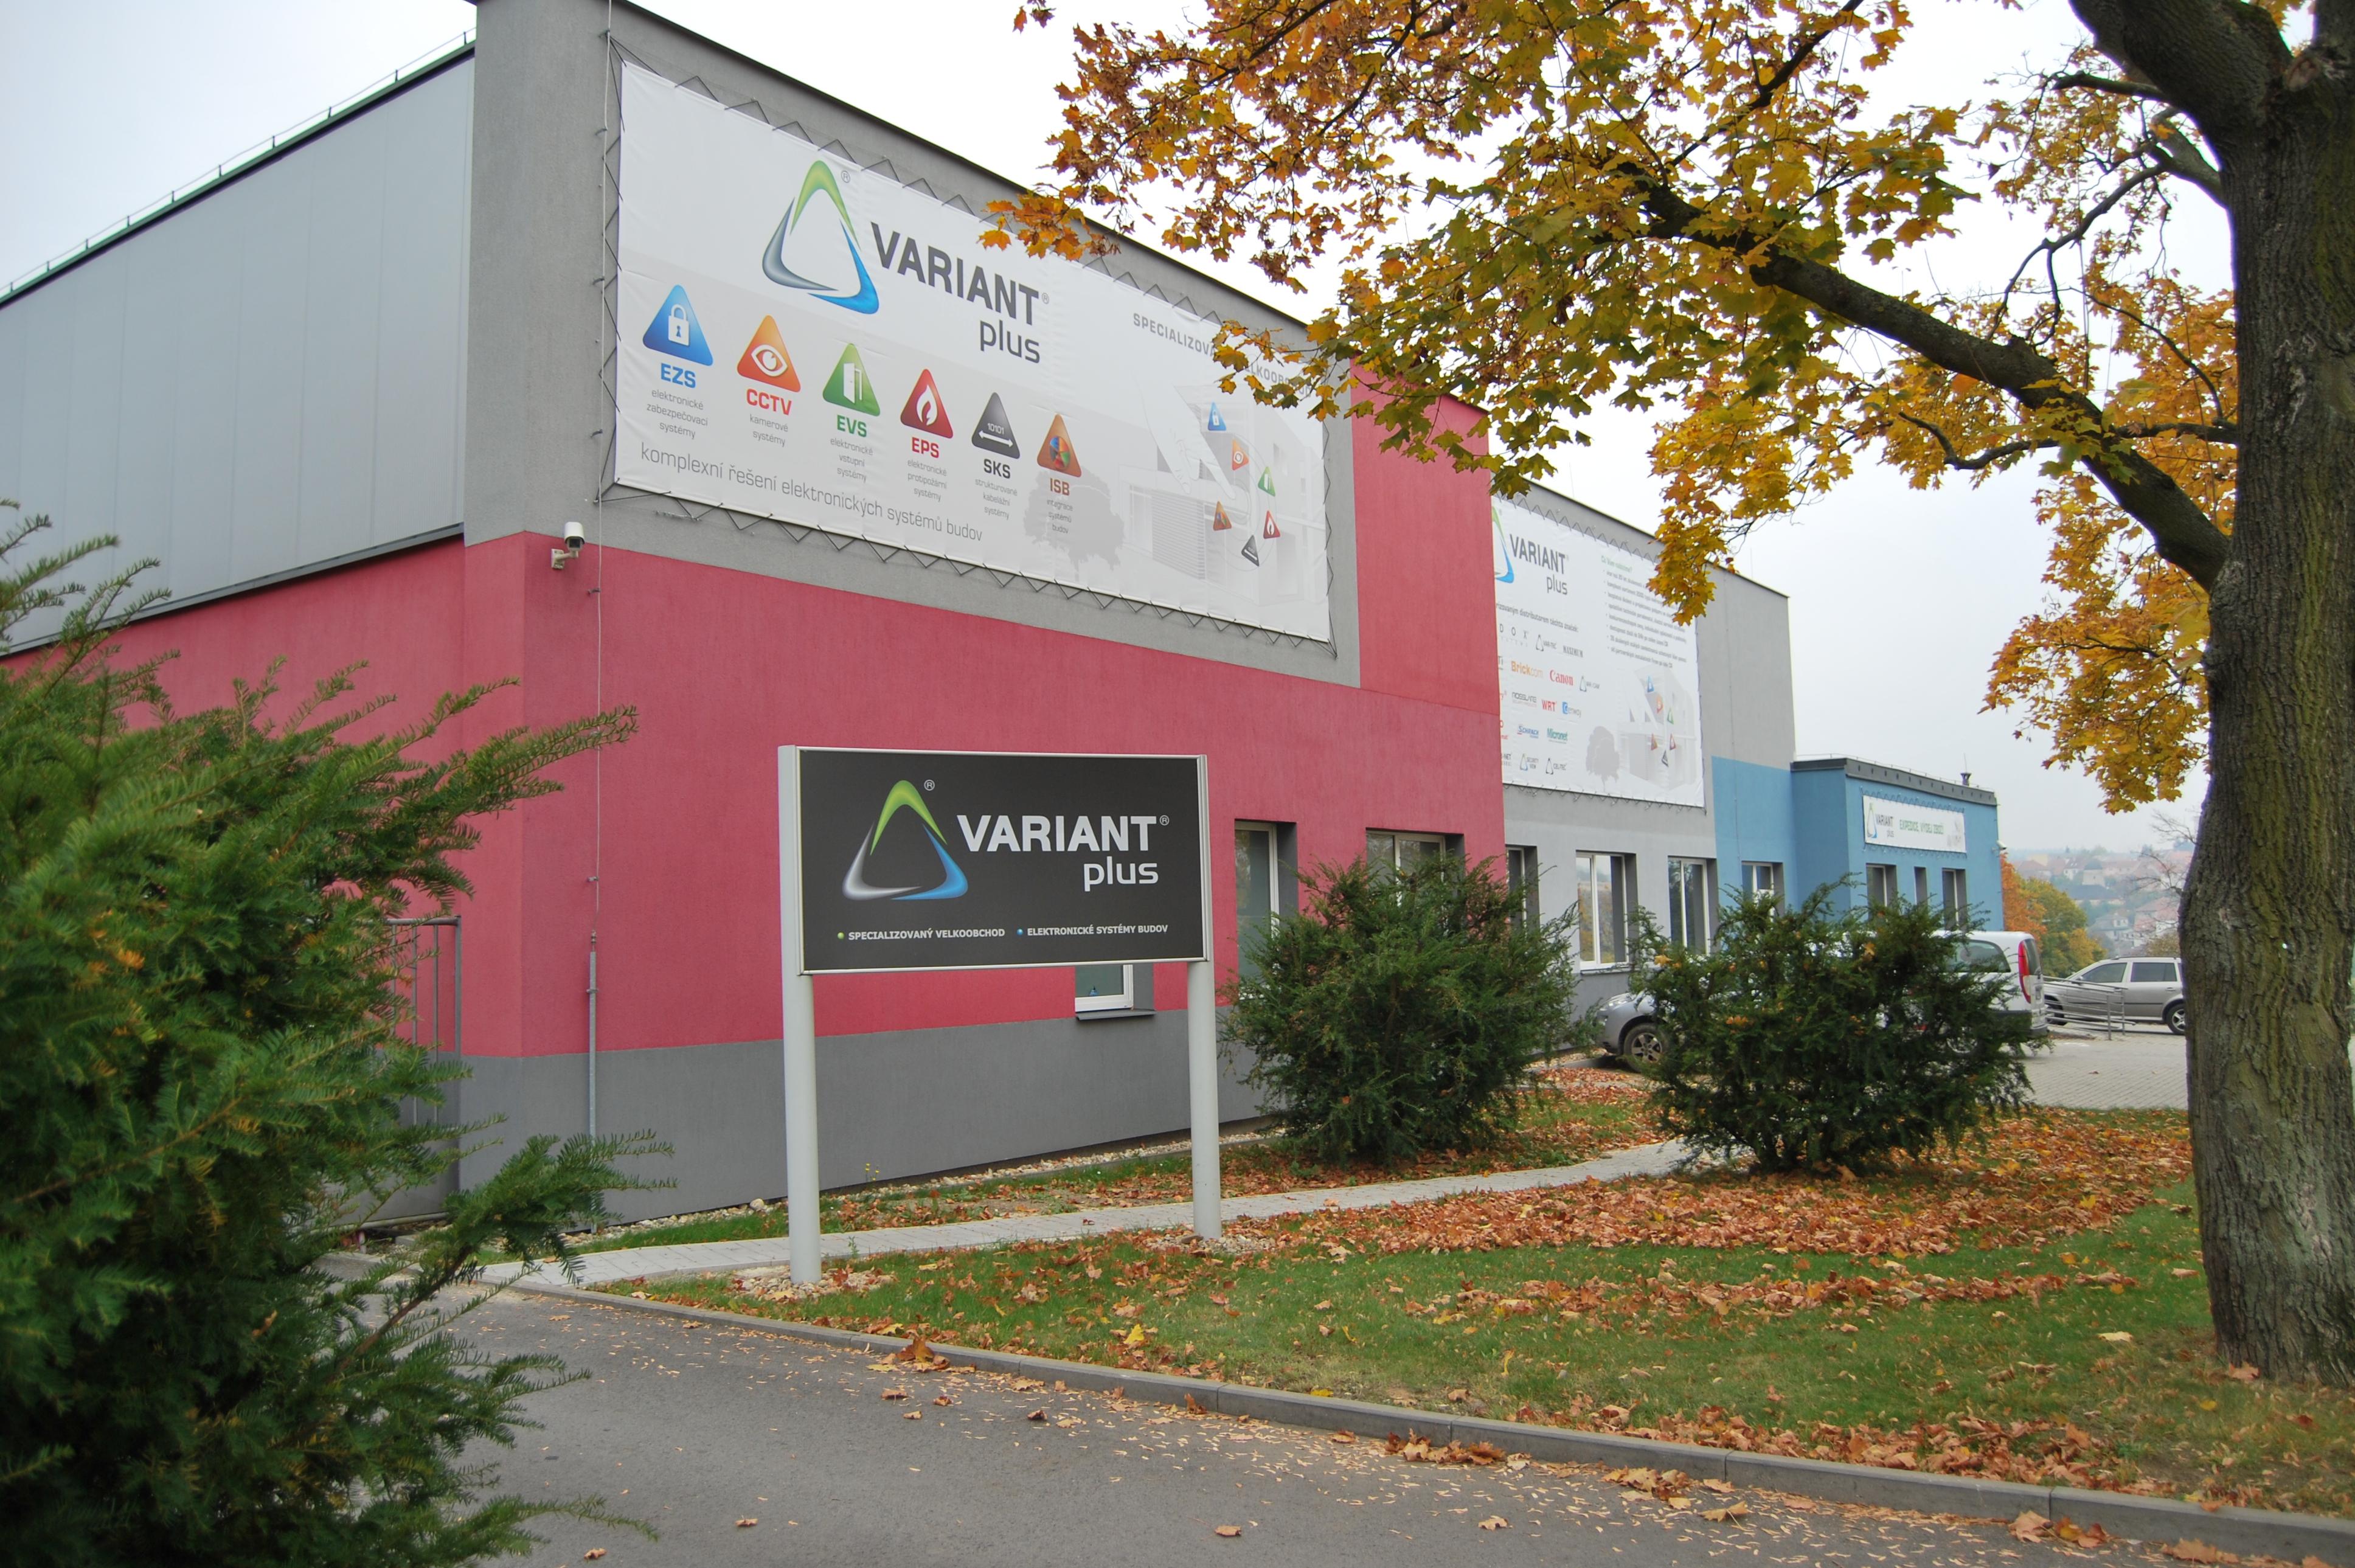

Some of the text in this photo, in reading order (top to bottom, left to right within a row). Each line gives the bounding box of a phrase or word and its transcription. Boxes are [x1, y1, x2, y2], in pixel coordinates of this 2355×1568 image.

[870, 221, 1039, 326] VARIANT
[980, 319, 1041, 364] plus
[1132, 313, 1218, 358] SPECIALIZOVA
[661, 363, 696, 389] EZS
[651, 389, 704, 411] elektronické
[746, 388, 792, 415] CCTV
[647, 403, 708, 426] zabezpečovací
[749, 414, 789, 432] kamerové
[659, 422, 696, 440] systémy
[837, 414, 867, 437] EVS
[987, 423, 1005, 435] 10101
[752, 429, 786, 448] systémy
[830, 437, 873, 456] elektronické
[911, 437, 940, 459] EPS
[839, 454, 865, 467] vstupní
[907, 459, 947, 477] elektronické
[983, 458, 1011, 479] SKS
[837, 467, 867, 483] systémy
[641, 442, 983, 541] komplexní řešení elektronických systémů budov
[914, 487, 942, 502] systémy
[1050, 477, 1070, 496] ISB
[984, 506, 1010, 521] systémy
[1510, 533, 1566, 575] VARIANT
[1547, 576, 1568, 595] plus
[1511, 660, 1543, 678] Brickcom
[1549, 670, 1574, 687] Canon
[956, 814, 1157, 852] VARIANT
[1083, 856, 1159, 892] plus
[848, 924, 1168, 941] SPECIALIZOVANÝ VELKOOBCHOD ELEKTRONICKÉ SYSTÉMY BUDOV
